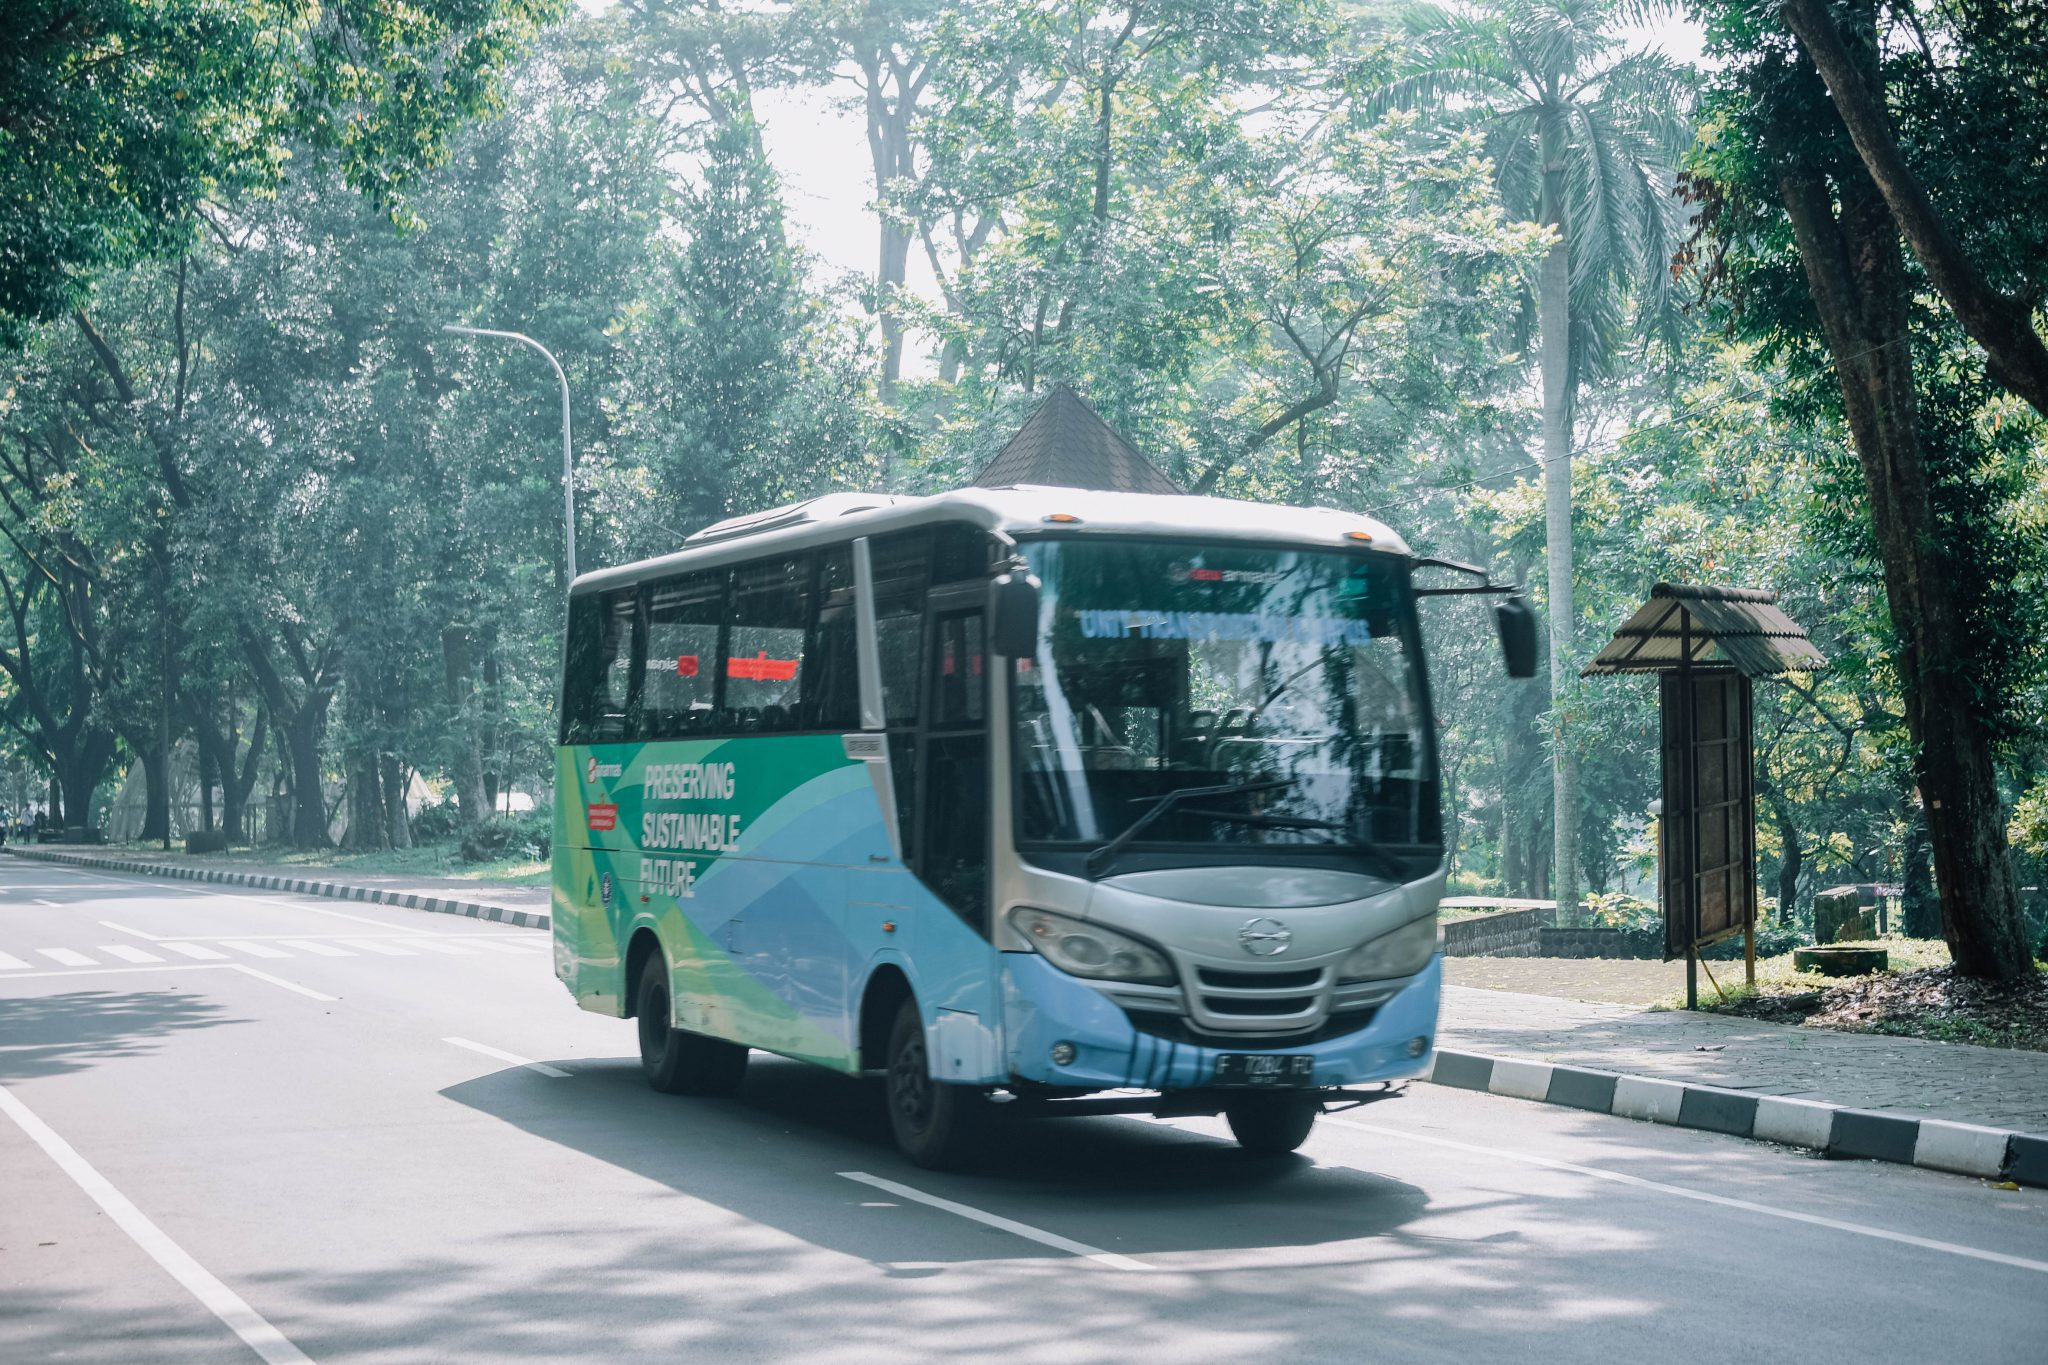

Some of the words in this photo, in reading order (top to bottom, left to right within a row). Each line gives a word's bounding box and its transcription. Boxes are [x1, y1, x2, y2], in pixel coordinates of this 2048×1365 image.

[643, 762, 736, 800] PRESERVING
[641, 812, 741, 851] SUSTAINABLE
[639, 858, 697, 898] FUTURE
[1216, 1055, 1231, 1074] F
